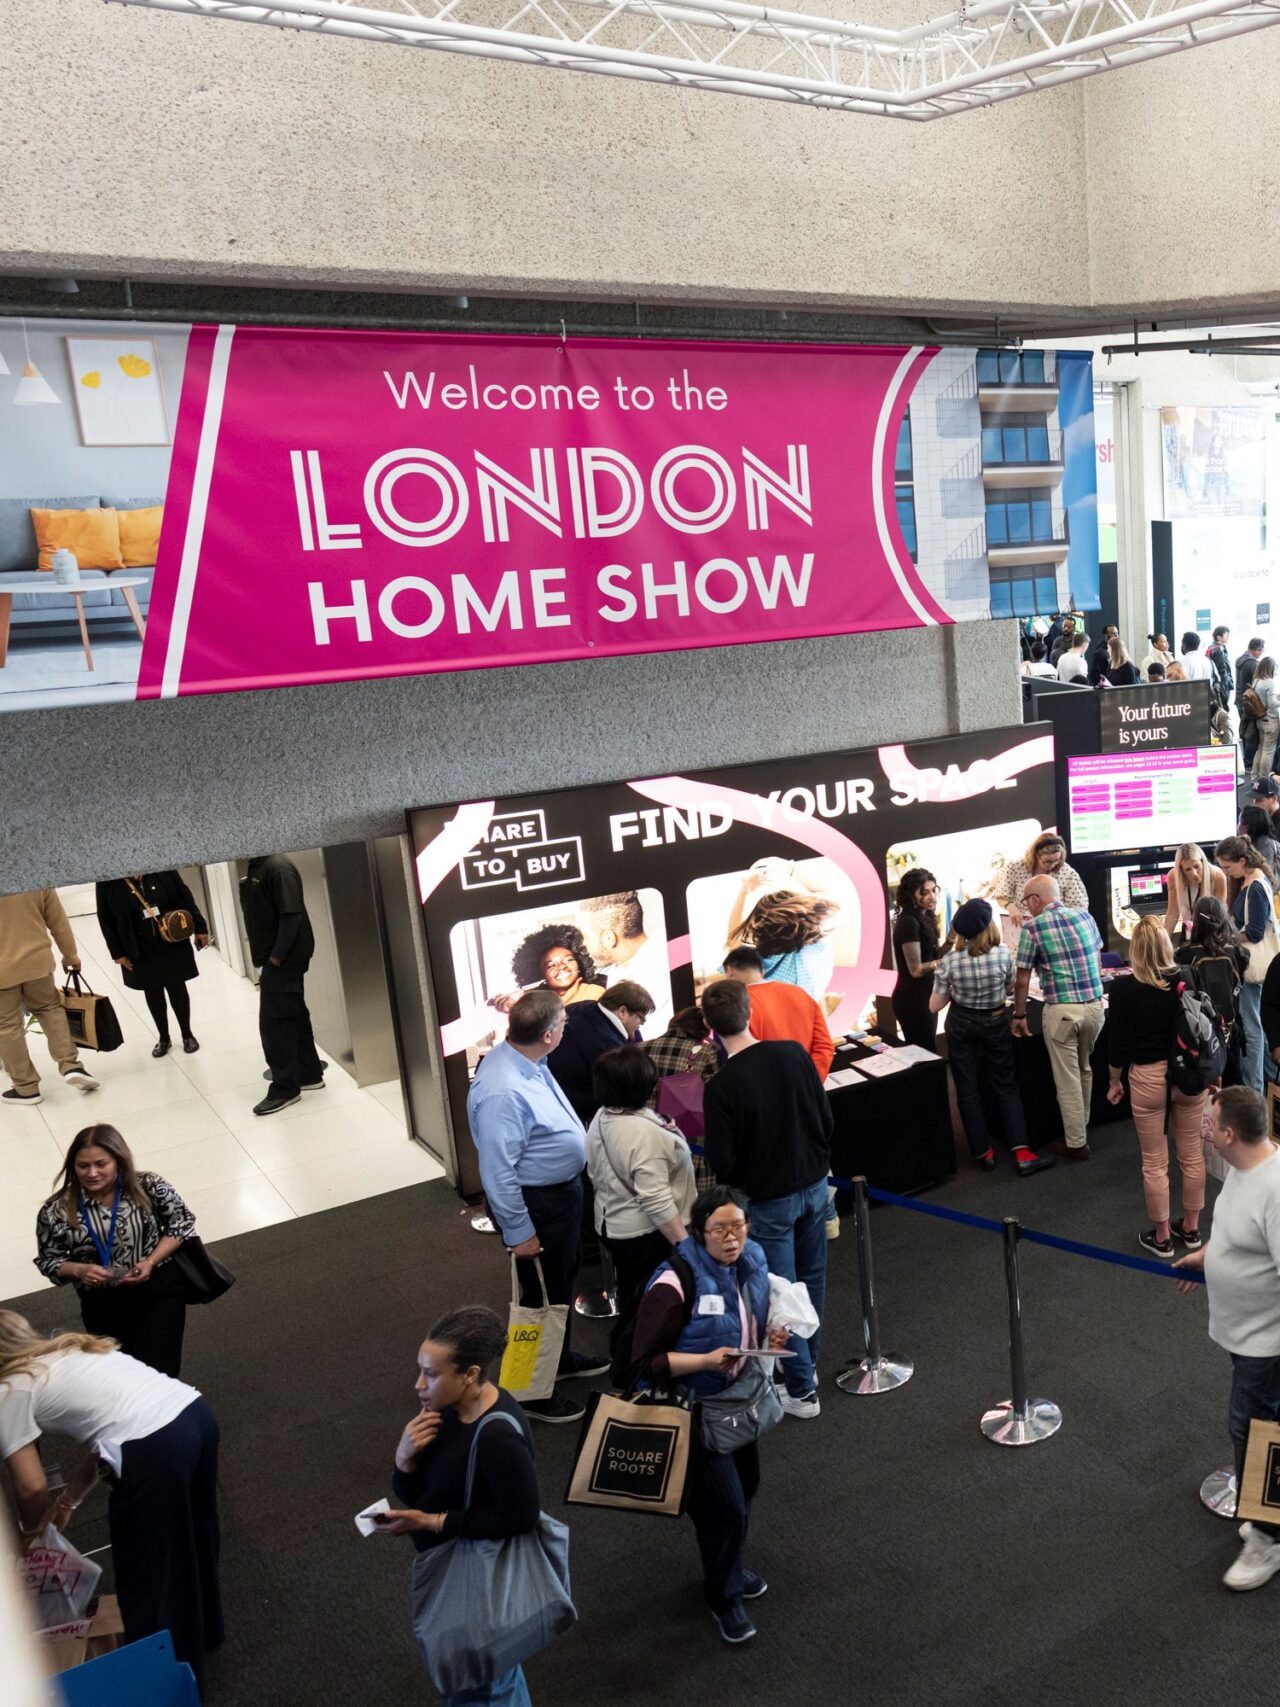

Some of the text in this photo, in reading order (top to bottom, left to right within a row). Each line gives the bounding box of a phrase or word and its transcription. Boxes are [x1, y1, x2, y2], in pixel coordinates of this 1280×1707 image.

[384, 365, 729, 411] Welcome to the
[290, 443, 814, 551] LONDON
[308, 553, 815, 646] HOME SHOW
[1118, 702, 1191, 723] Your future
[1119, 726, 1169, 747] is yours
[609, 802, 734, 852] FIND
[752, 778, 877, 828] YOUR
[473, 853, 571, 877] TO BUY
[513, 1330, 538, 1342] L&Q
[607, 1446, 664, 1464] SQUARE
[608, 1460, 656, 1476] ROOTS
